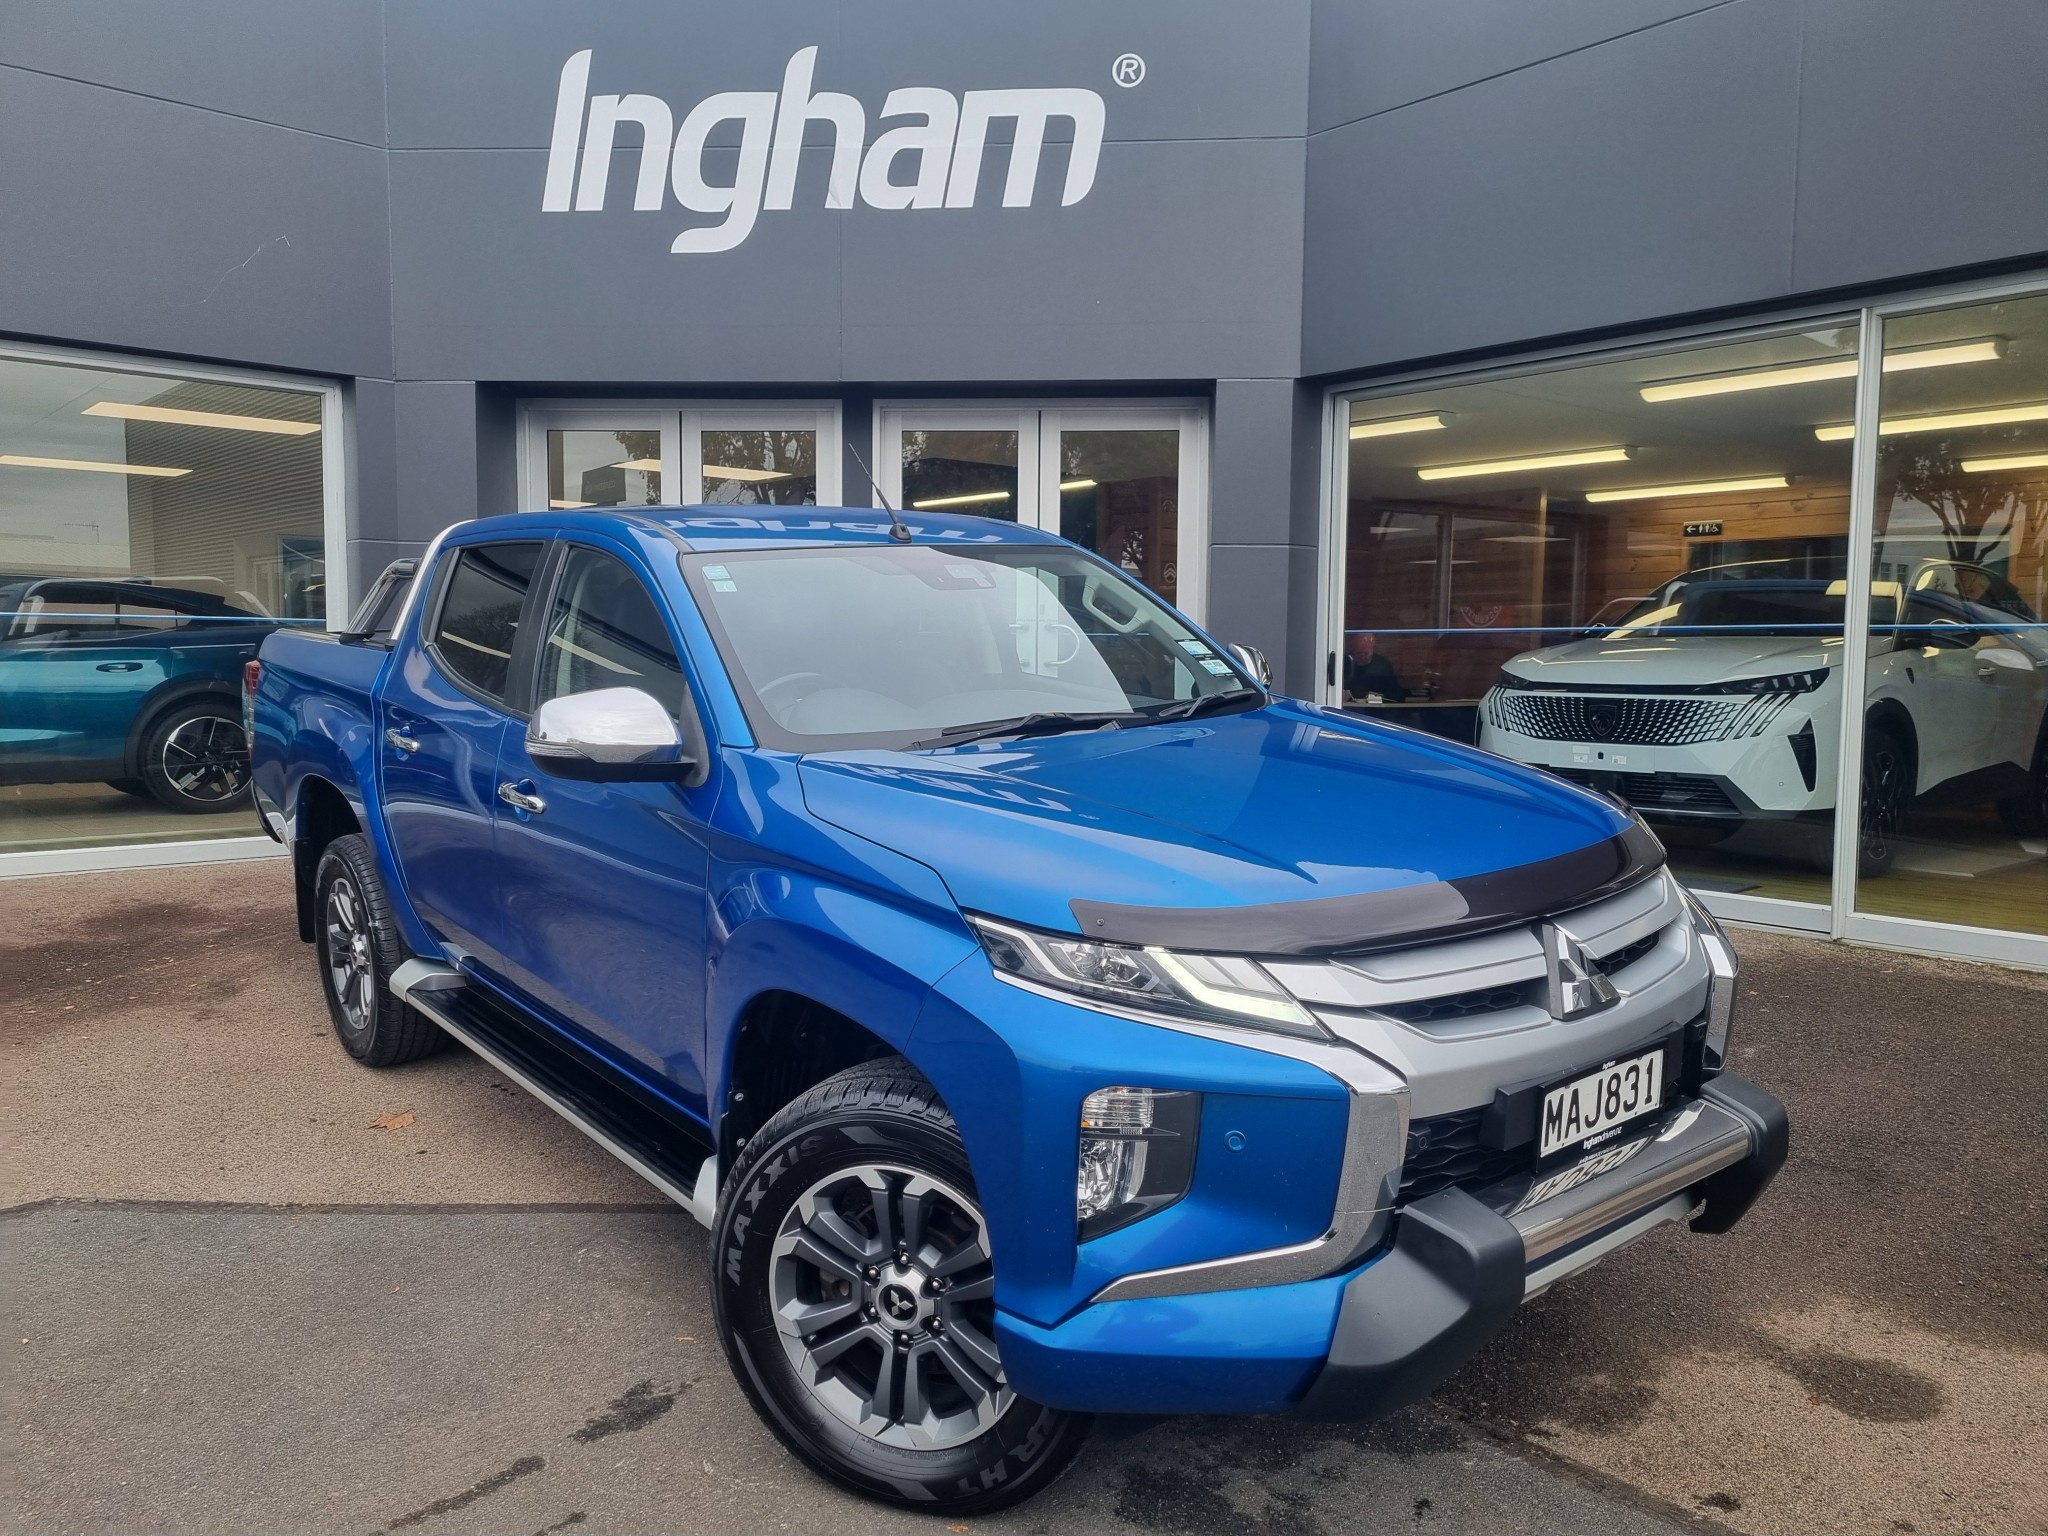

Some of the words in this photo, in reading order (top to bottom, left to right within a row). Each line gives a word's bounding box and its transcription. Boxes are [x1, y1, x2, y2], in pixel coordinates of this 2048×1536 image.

[541, 45, 1106, 254] Ingham
[1543, 1057, 1654, 1148] MAJ831
[726, 1135, 824, 1287] MAXXIS
